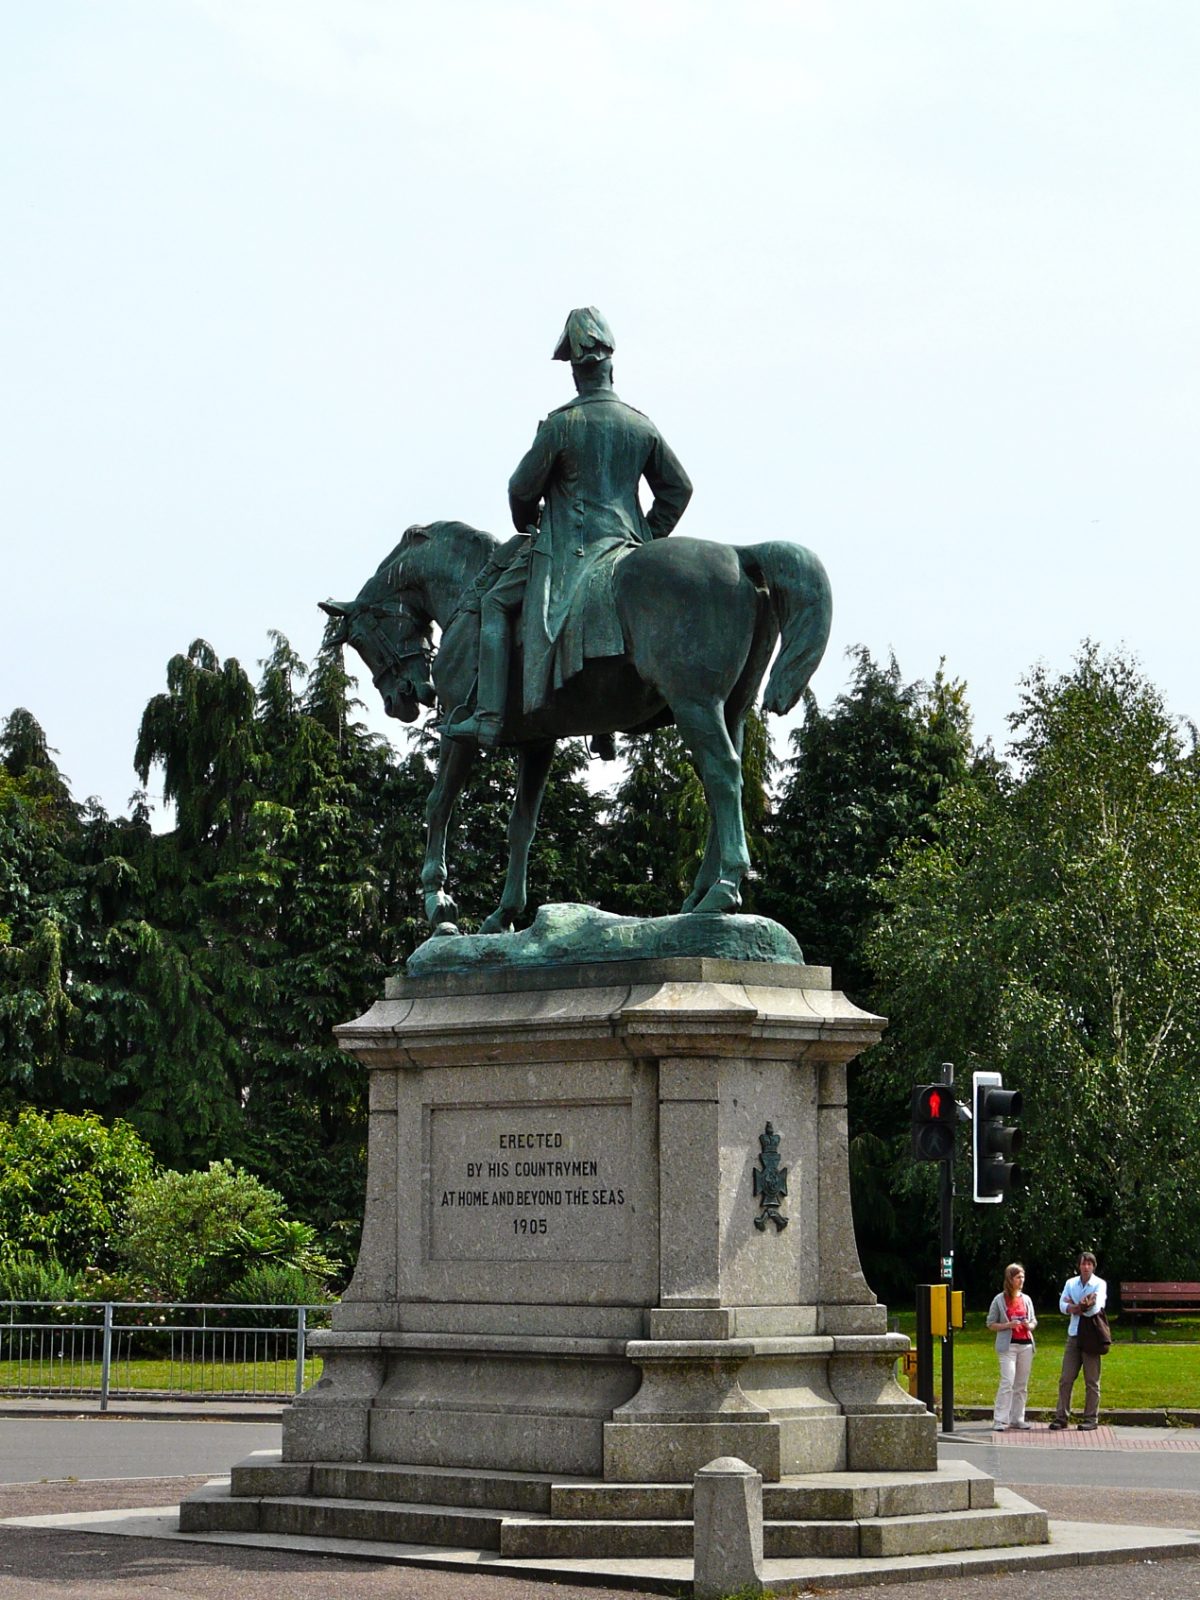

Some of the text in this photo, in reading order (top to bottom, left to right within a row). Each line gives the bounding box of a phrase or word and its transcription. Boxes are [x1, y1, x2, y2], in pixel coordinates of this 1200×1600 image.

[500, 1133, 562, 1149] ERECTED
[467, 1161, 598, 1177] BY HIS COUNTRYMEN
[441, 1189, 625, 1207] AT HOME AND BEYOND THE SEAS
[513, 1219, 547, 1234] 1905
